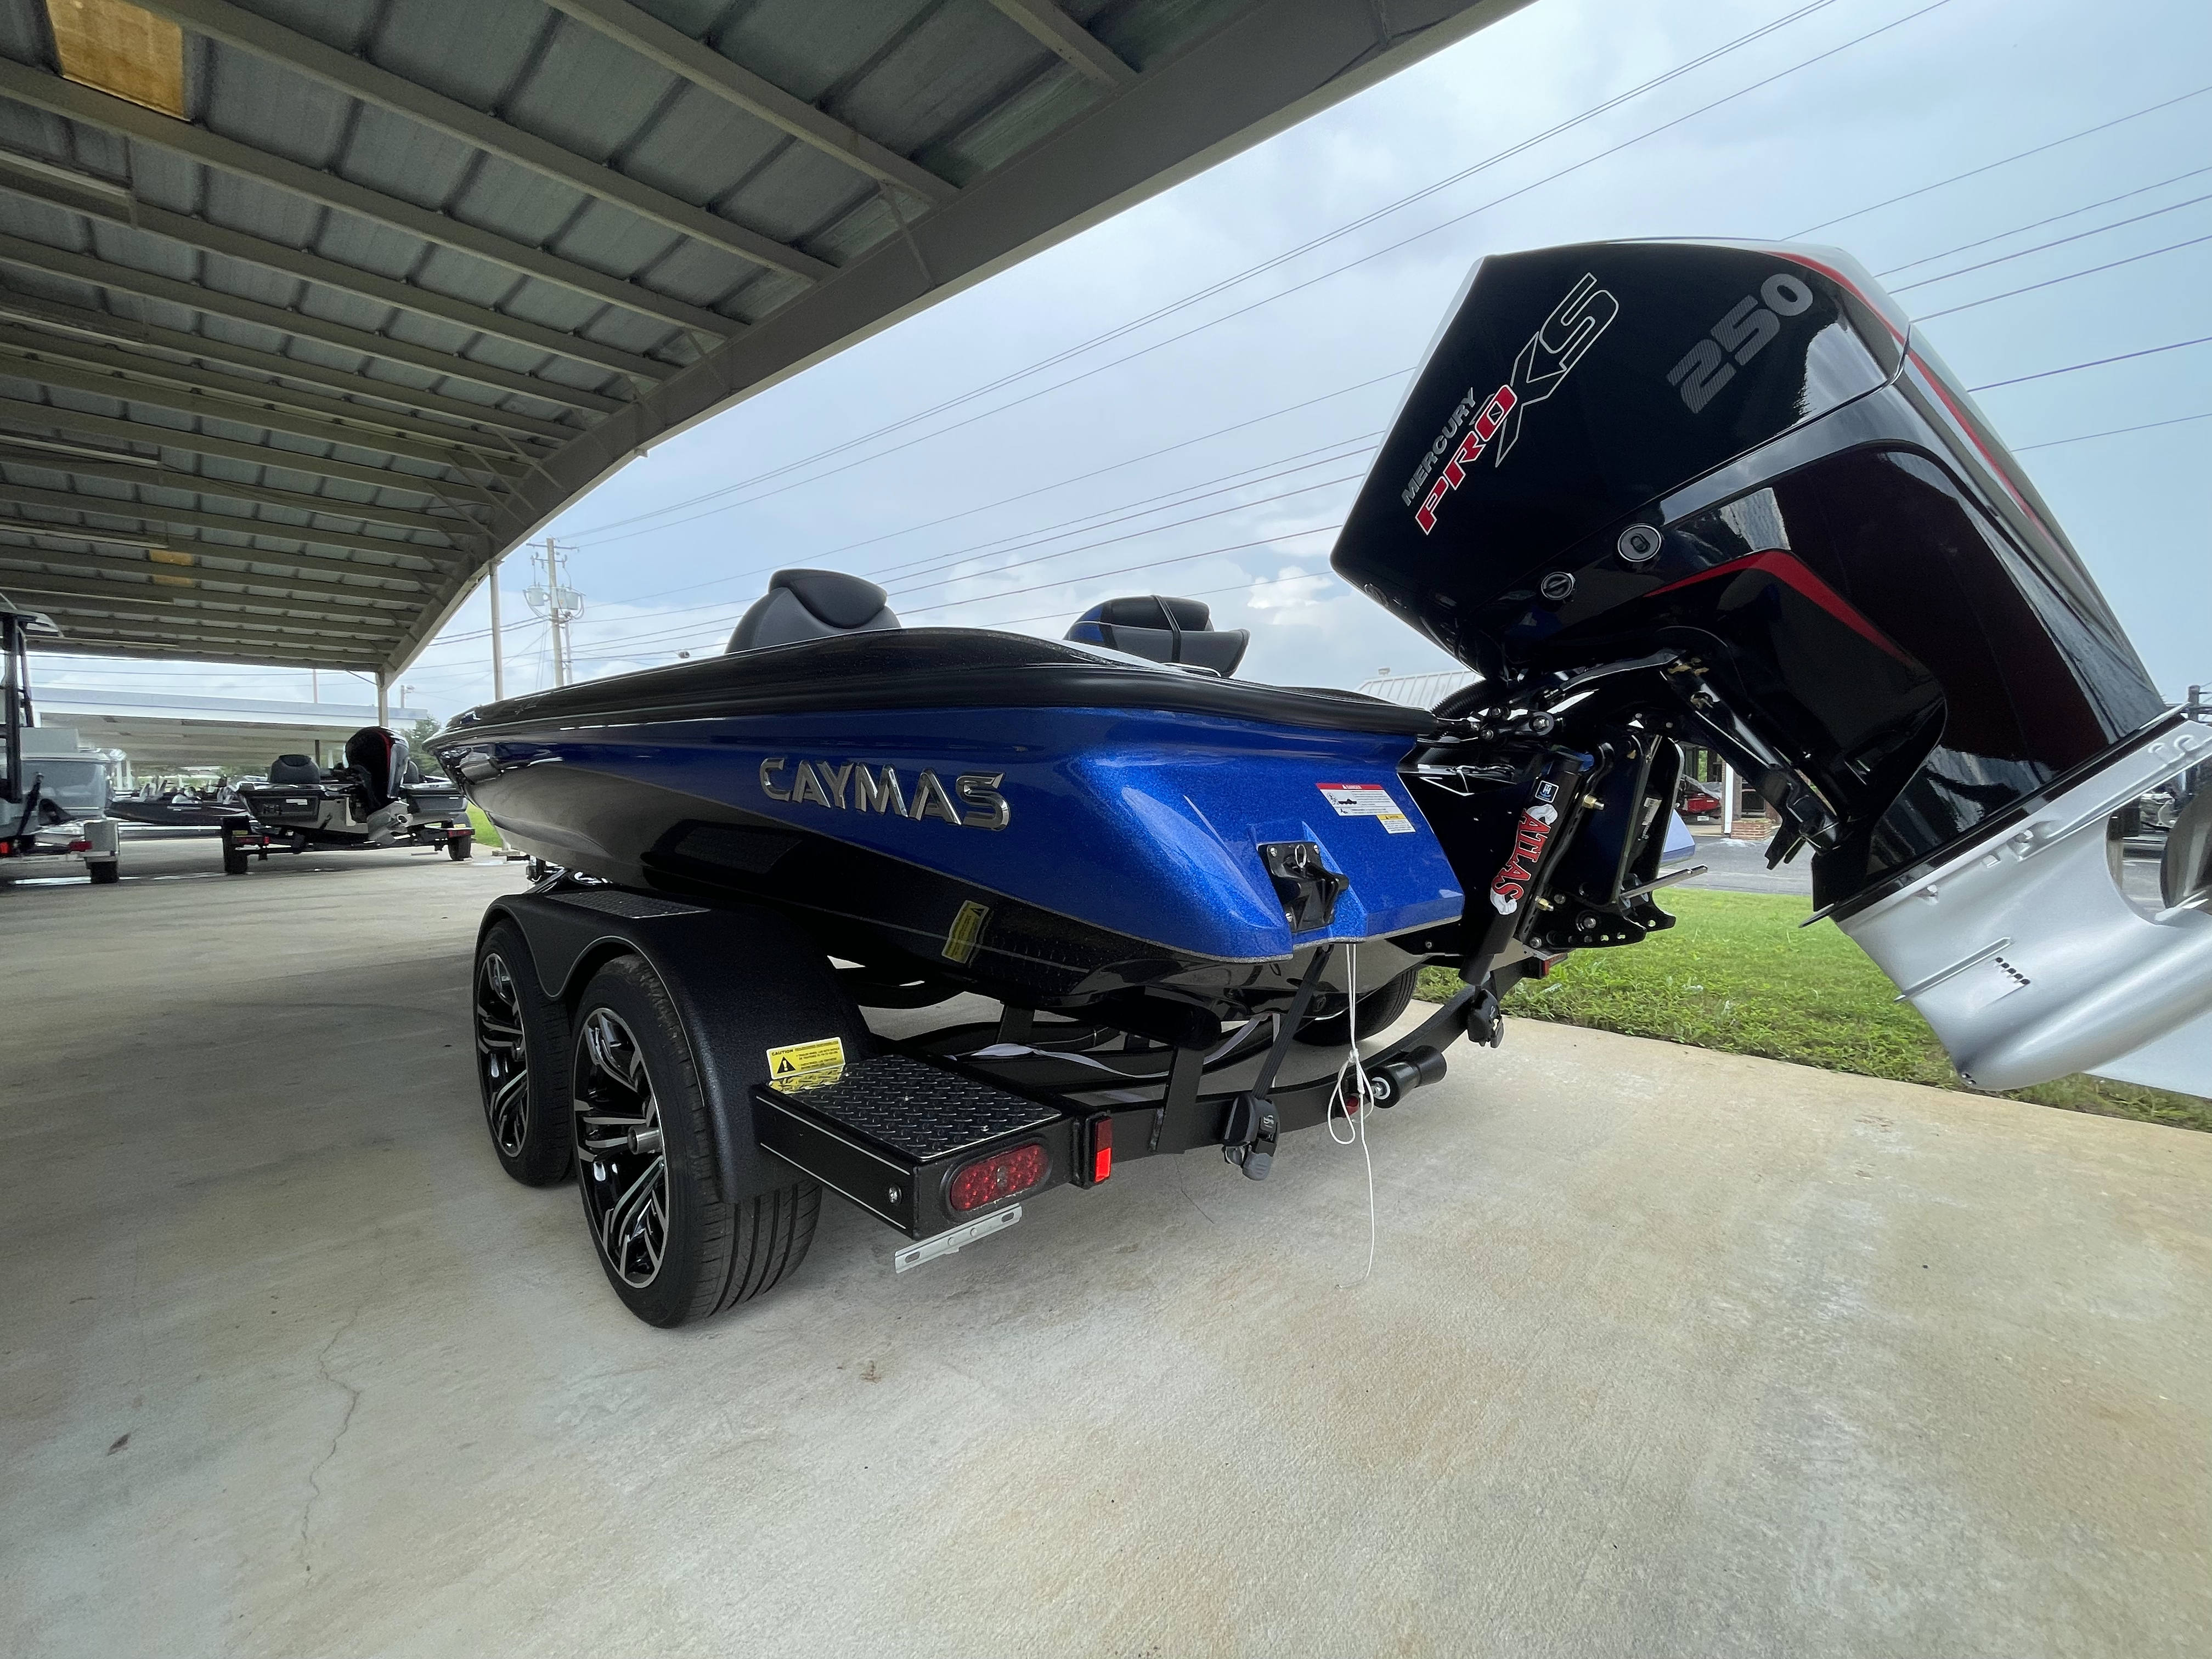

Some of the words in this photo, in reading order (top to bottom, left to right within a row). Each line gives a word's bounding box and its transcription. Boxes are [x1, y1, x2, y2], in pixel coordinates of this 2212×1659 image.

[1666, 273, 1814, 414] 250
[1401, 387, 1476, 506] MERCURY
[760, 758, 1011, 831] CAYMAS
[1491, 808, 1551, 901] ATLAS
